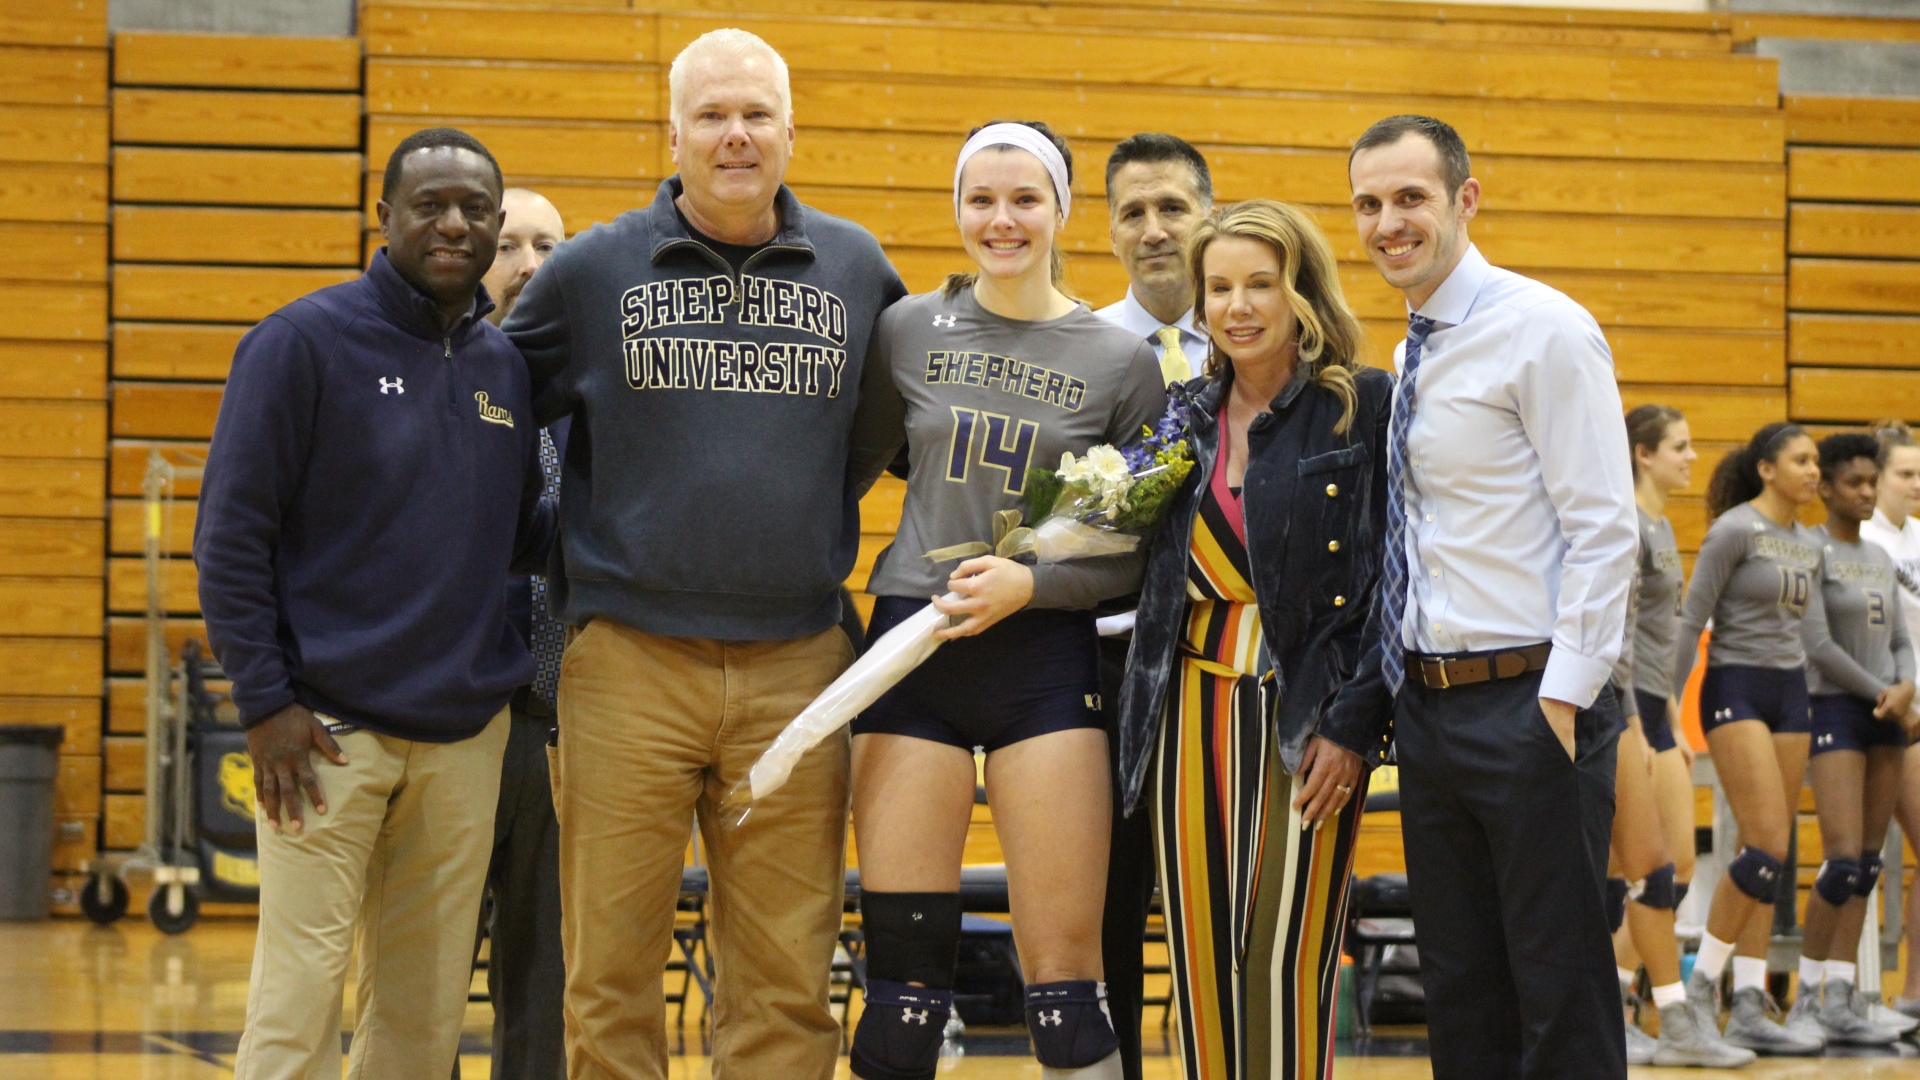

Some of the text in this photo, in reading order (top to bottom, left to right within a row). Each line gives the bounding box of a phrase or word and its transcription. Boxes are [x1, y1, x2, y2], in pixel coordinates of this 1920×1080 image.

[621, 274, 847, 346] SHEPHERD
[623, 337, 846, 398] UNIVERSITY
[925, 351, 1086, 412] SHEPHERD
[945, 406, 1040, 496] 14
[1777, 565, 1810, 610] 10
[1862, 587, 1886, 629] 3
